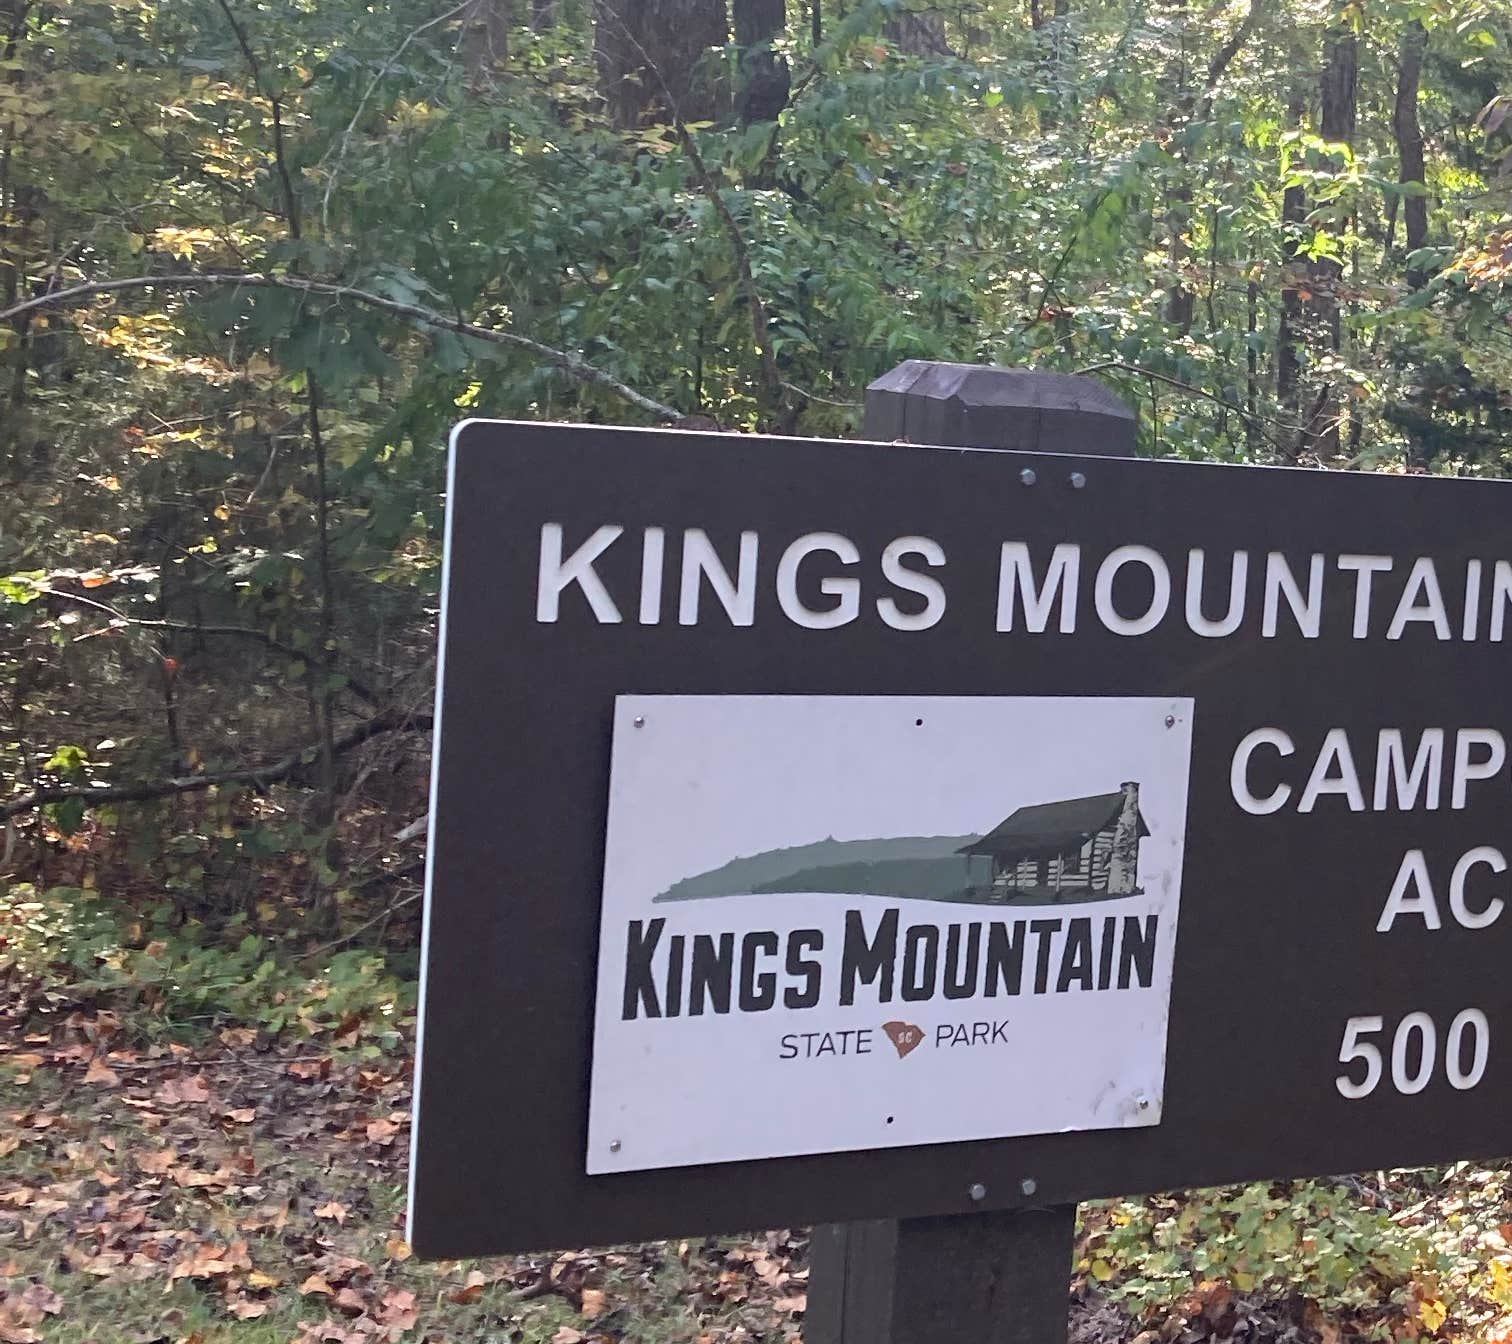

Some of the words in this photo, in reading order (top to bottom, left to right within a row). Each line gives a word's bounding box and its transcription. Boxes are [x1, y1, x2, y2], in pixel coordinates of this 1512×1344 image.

[537, 523, 946, 631] KINGS
[621, 917, 824, 1021] KINGS
[838, 908, 1159, 1007] MOUNTAIN
[779, 1029, 873, 1060] STATE
[897, 1031, 913, 1044] SC
[935, 1020, 1010, 1049] PARK
[1336, 1009, 1490, 1100] 500
